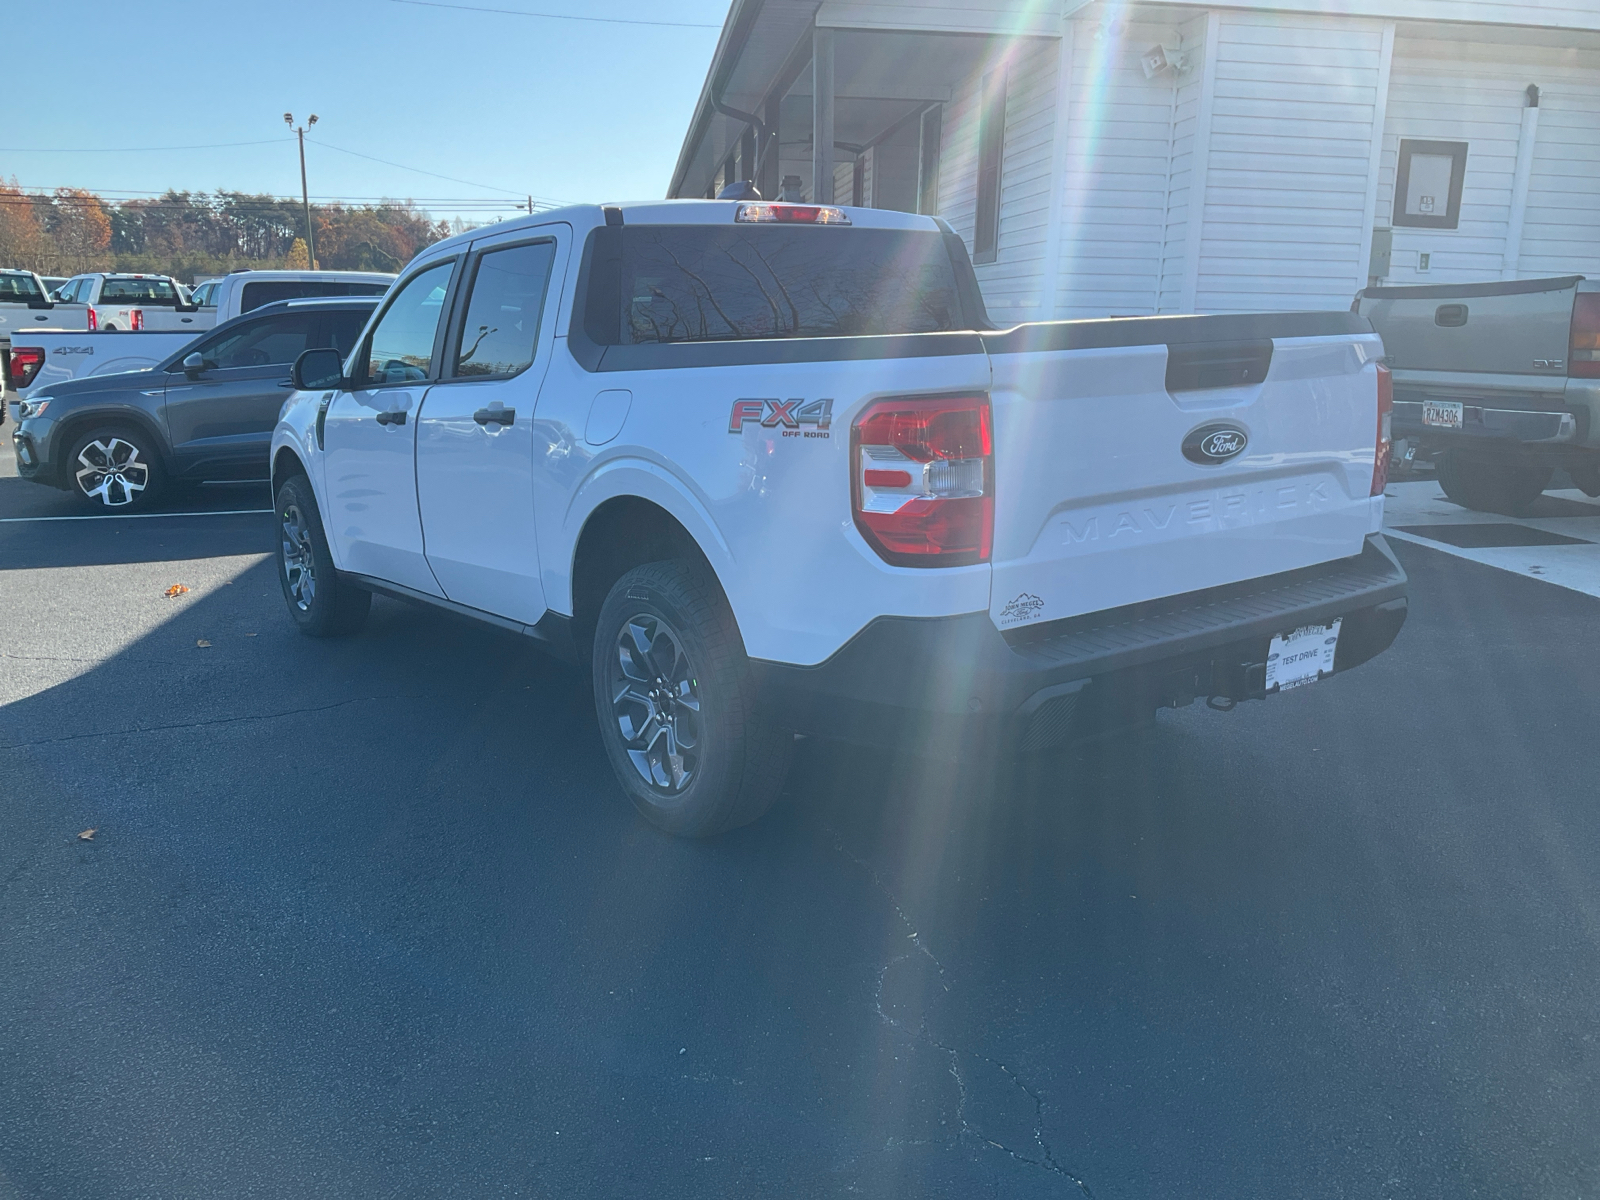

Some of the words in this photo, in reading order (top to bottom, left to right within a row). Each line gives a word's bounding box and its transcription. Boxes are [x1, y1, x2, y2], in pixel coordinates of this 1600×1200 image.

[1533, 359, 1563, 369] GMC
[728, 398, 834, 434] FX4
[782, 430, 801, 438] OFF
[803, 431, 830, 439] ROAD
[1210, 434, 1239, 453] Ford
[1060, 480, 1328, 545] MAVERICK
[1005, 603, 1020, 612] JOHN
[1282, 653, 1299, 666] TEST
[1299, 648, 1319, 661] DRIVE
